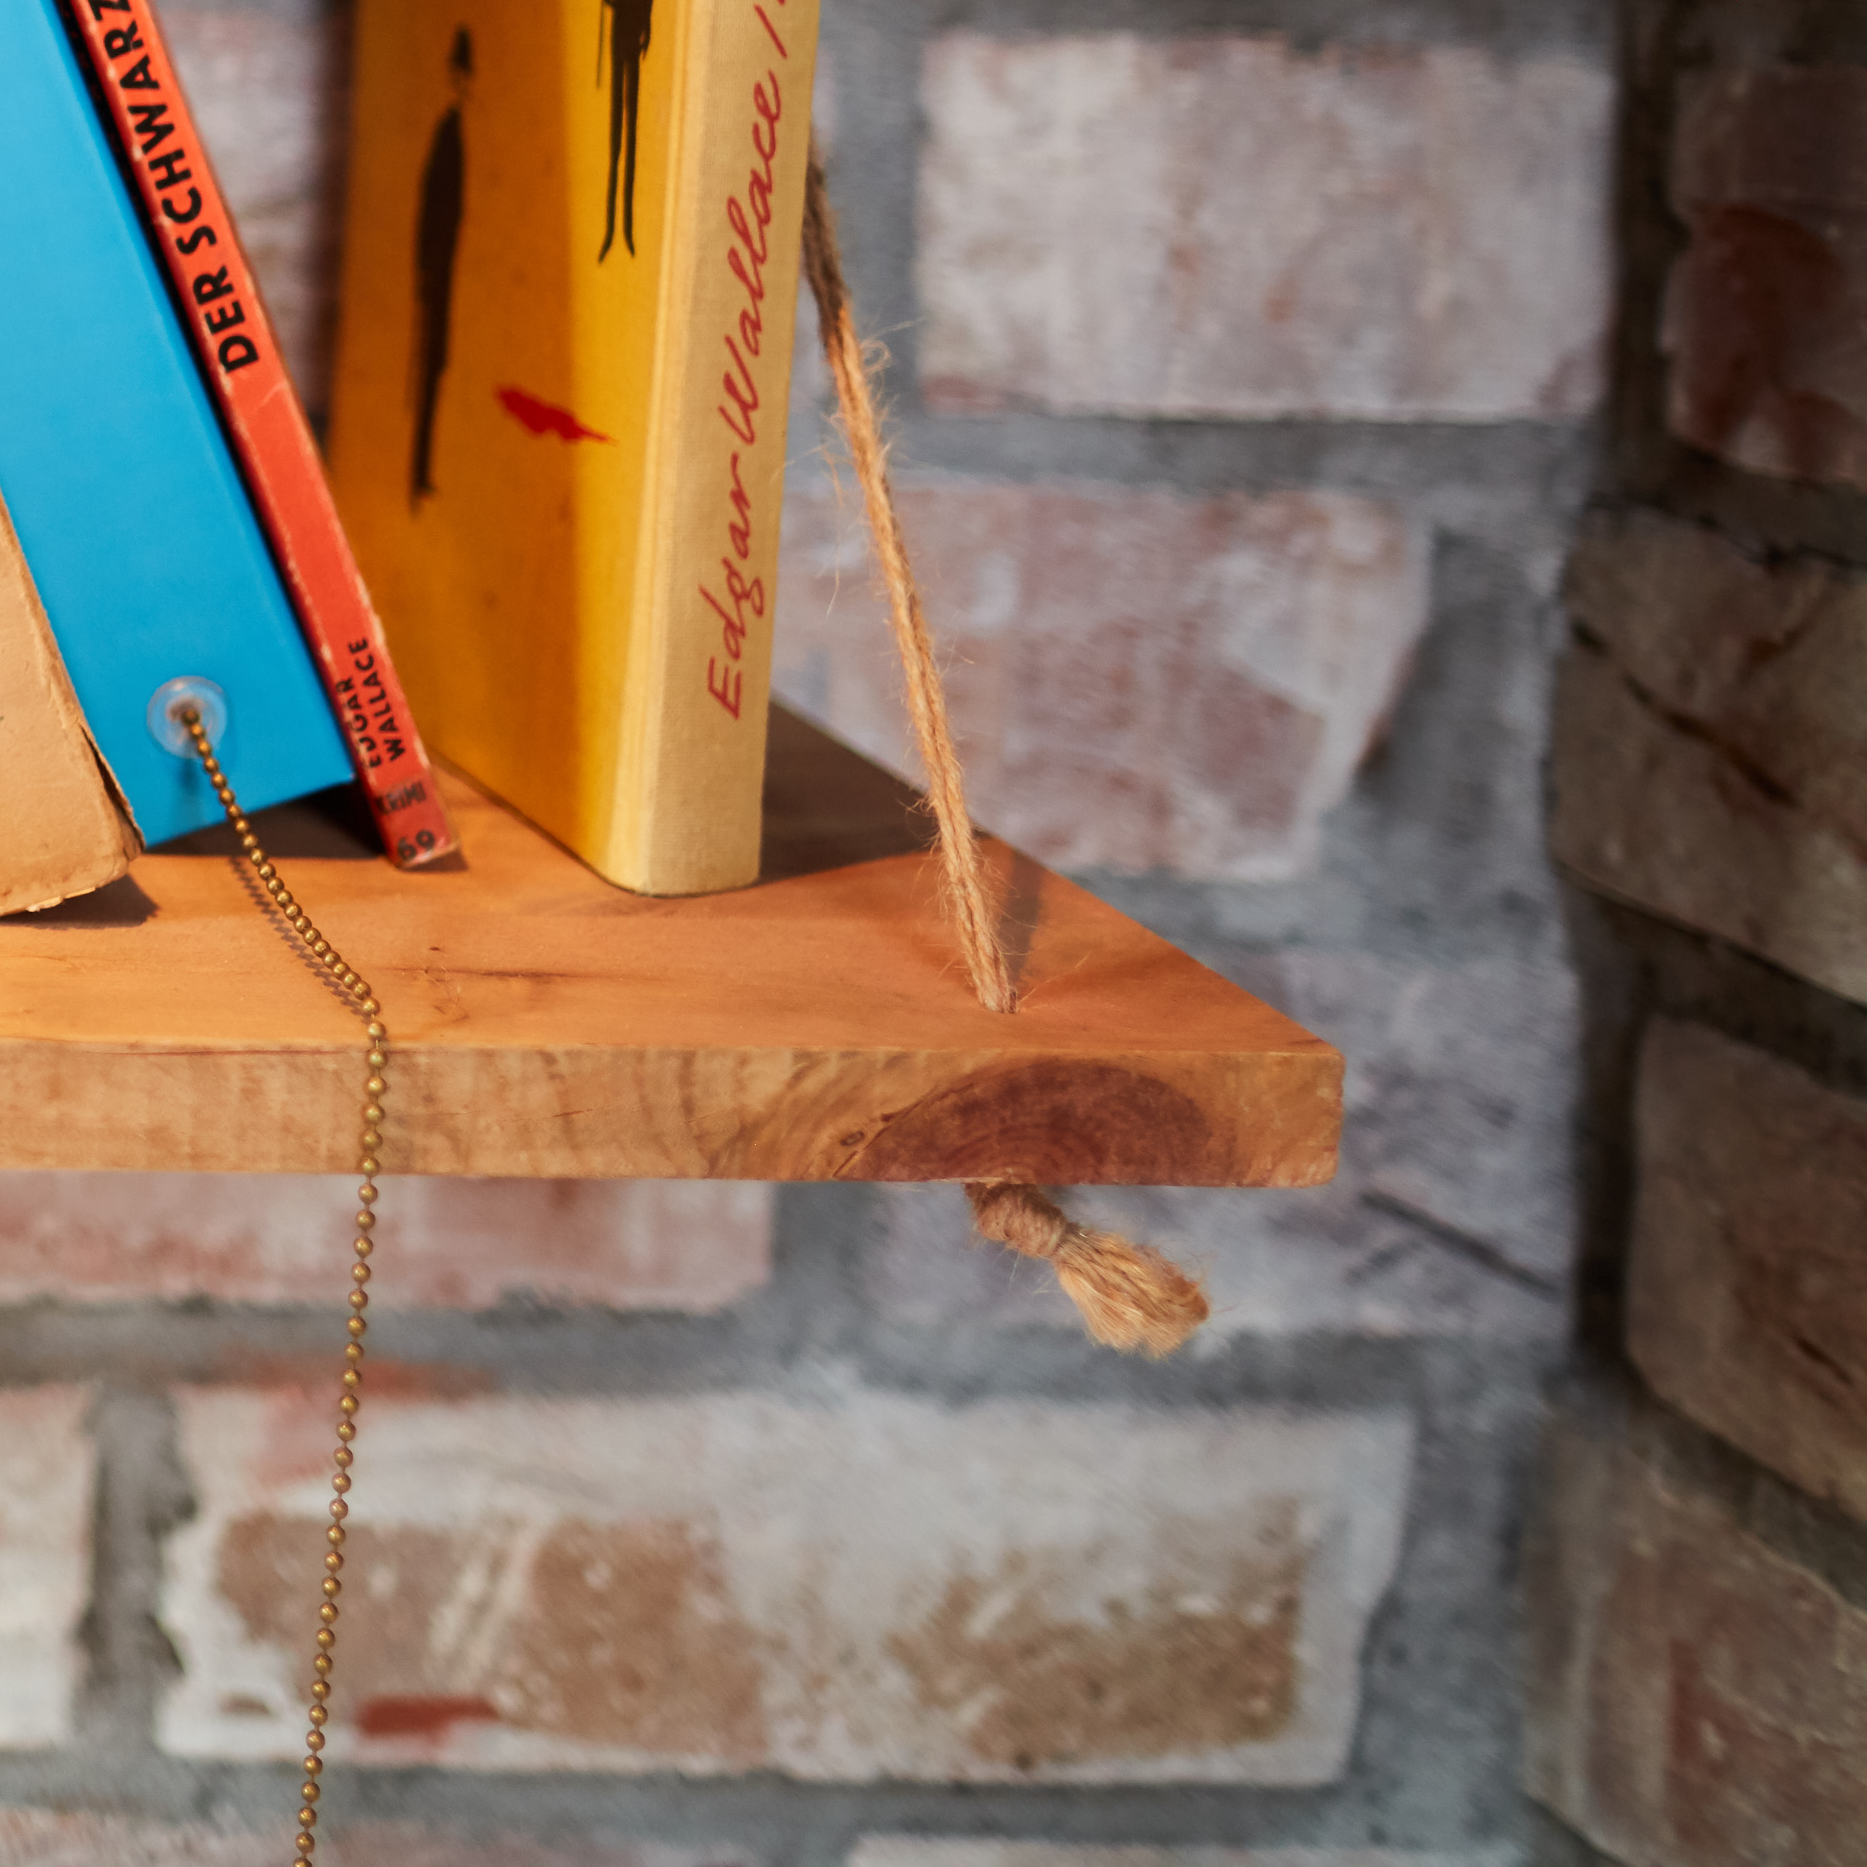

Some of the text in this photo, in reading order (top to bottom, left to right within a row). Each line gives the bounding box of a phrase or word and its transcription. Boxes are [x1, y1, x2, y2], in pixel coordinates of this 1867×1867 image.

[193, 266, 259, 375] DER
[718, 69, 781, 444] Wallace
[698, 453, 764, 721] Edgar
[348, 638, 406, 763] WALLACE
